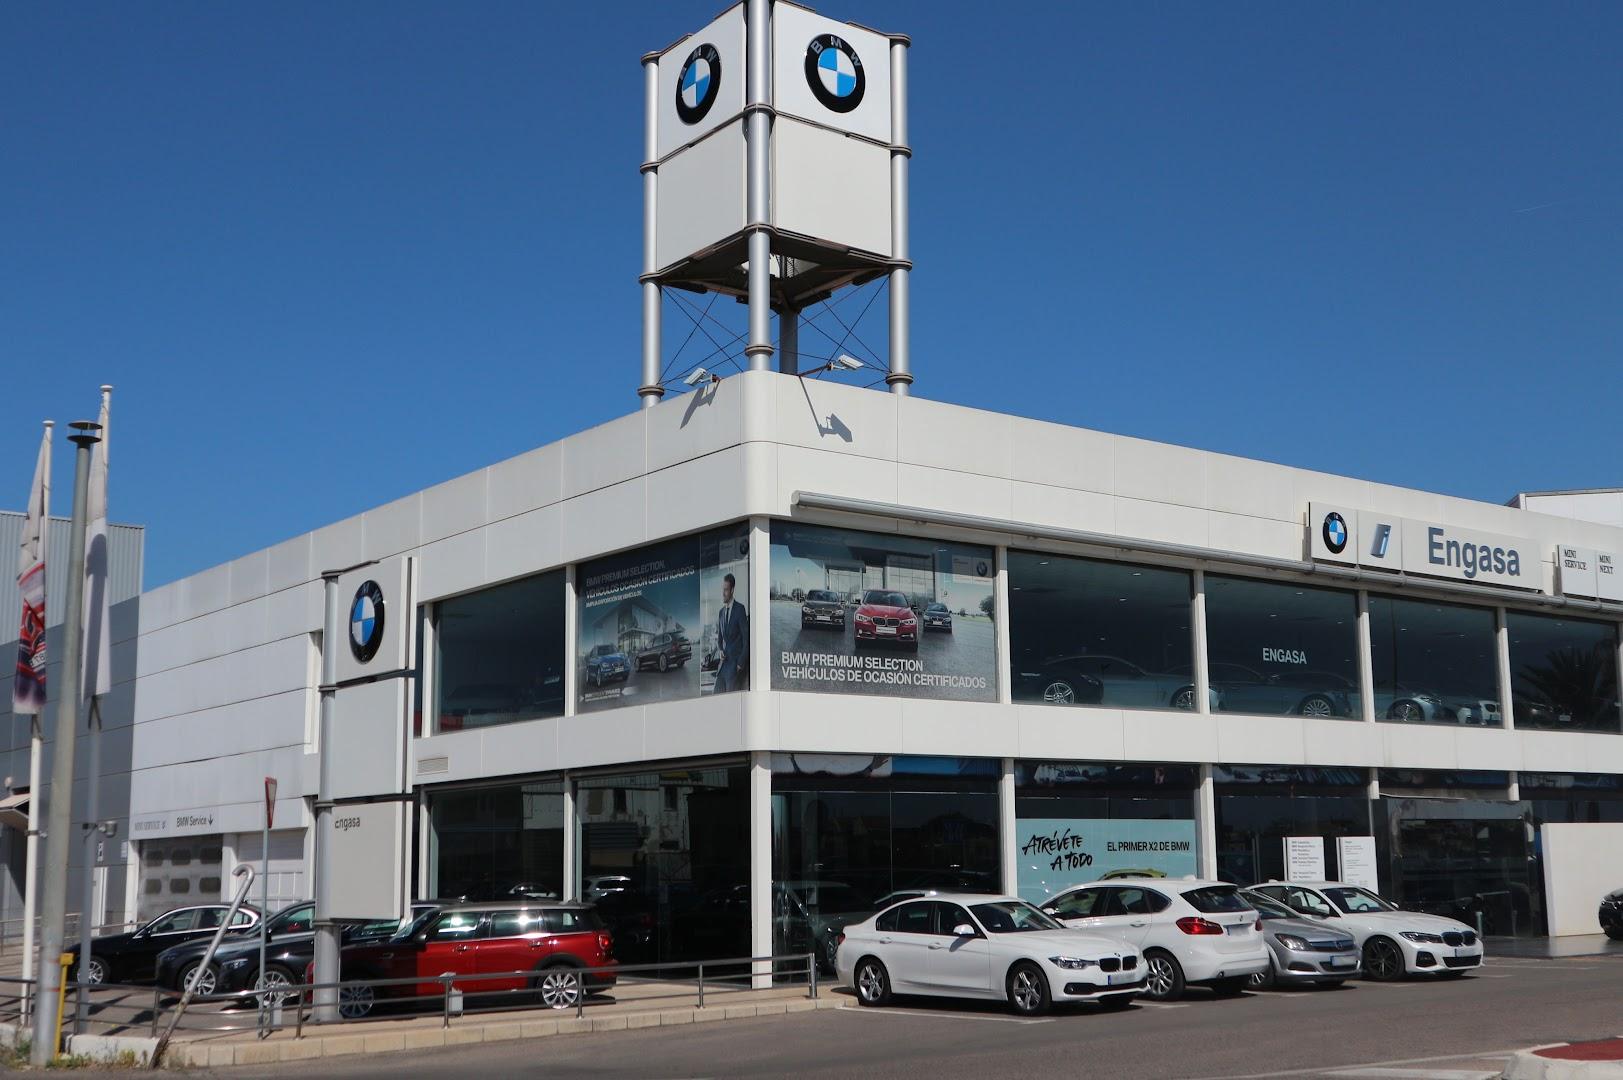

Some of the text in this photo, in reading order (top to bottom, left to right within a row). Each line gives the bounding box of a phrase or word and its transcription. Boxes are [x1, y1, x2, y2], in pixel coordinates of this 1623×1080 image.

[811, 35, 861, 66] BMW
[1428, 526, 1520, 579] Engasa
[1564, 549, 1576, 558] MINI
[1599, 555, 1611, 564] MINI
[1564, 559, 1587, 570] SERVICE
[1600, 565, 1613, 574] NEXT
[781, 651, 923, 671] BMW PREMIUM SELECTION
[1262, 647, 1307, 664] ENGASA
[781, 665, 986, 688] VEHÍCULOS DE OCASIÓN CERTIFICADOS
[176, 815, 207, 828] BMW Service
[1022, 828, 1083, 856] ATRÉVETE
[1107, 841, 1190, 851] EL PRIMER X2 DE BMW
[1050, 852, 1093, 871] A TODO
